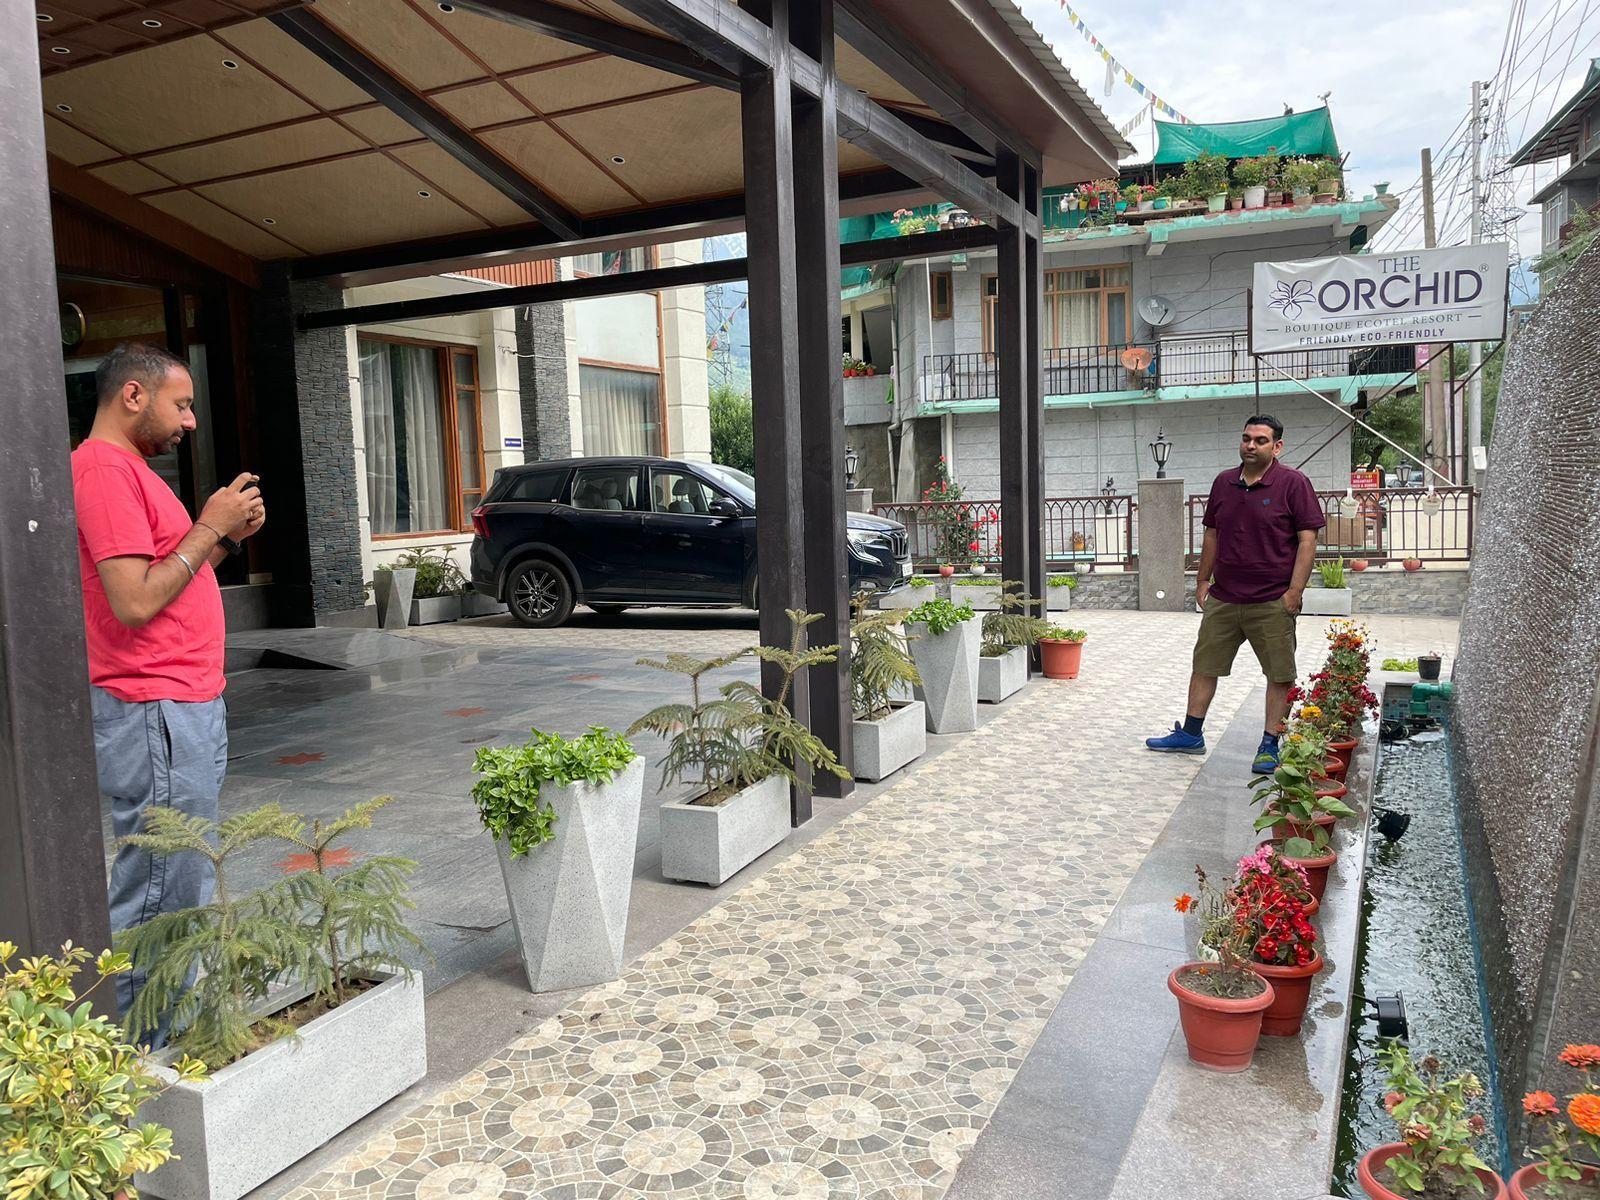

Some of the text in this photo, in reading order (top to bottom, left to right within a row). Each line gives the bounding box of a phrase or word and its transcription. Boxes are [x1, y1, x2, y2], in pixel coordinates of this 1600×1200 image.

[1378, 256, 1420, 274] THE
[1318, 269, 1483, 313] ORCHID
[1285, 313, 1463, 333] BOUTIQUE ECOTEL RESORT
[1360, 328, 1445, 342] ECO-FRIENDLY
